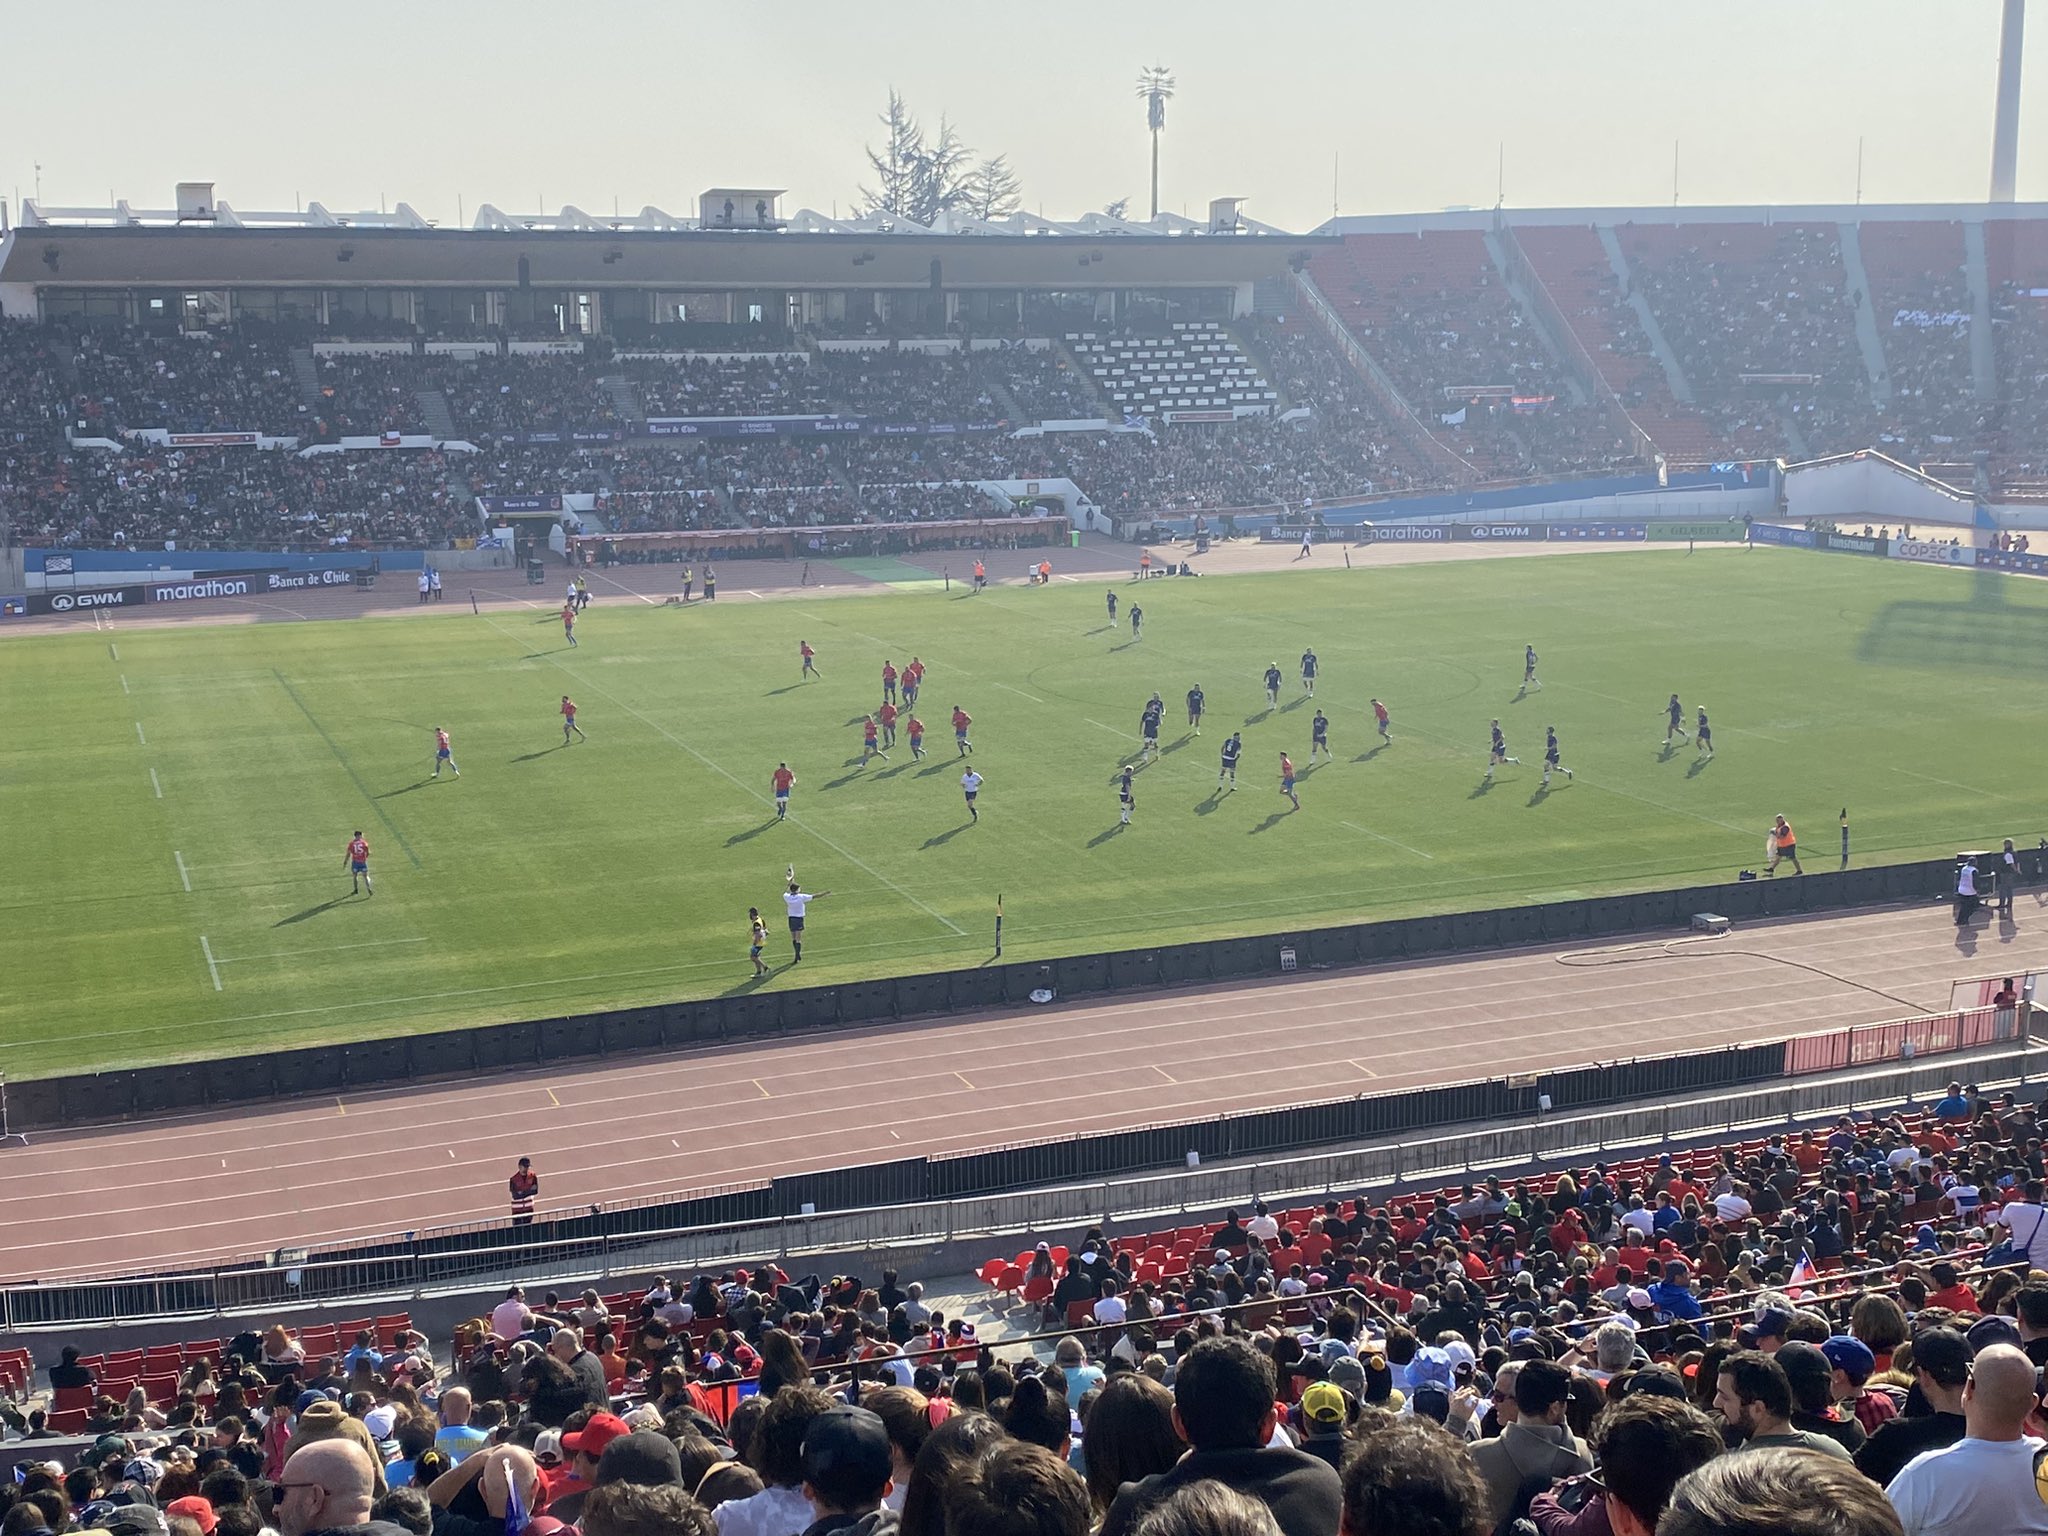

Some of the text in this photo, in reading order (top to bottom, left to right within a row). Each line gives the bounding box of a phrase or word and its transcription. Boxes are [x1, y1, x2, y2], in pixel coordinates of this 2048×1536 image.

[1271, 527, 1303, 539] Banco
[1491, 527, 1529, 536] GWM
[1899, 543, 1947, 559] COPEC
[268, 570, 350, 588] Banco de Chile
[156, 580, 247, 601] marathon
[77, 592, 123, 606] GWM
[353, 843, 364, 854] 15
